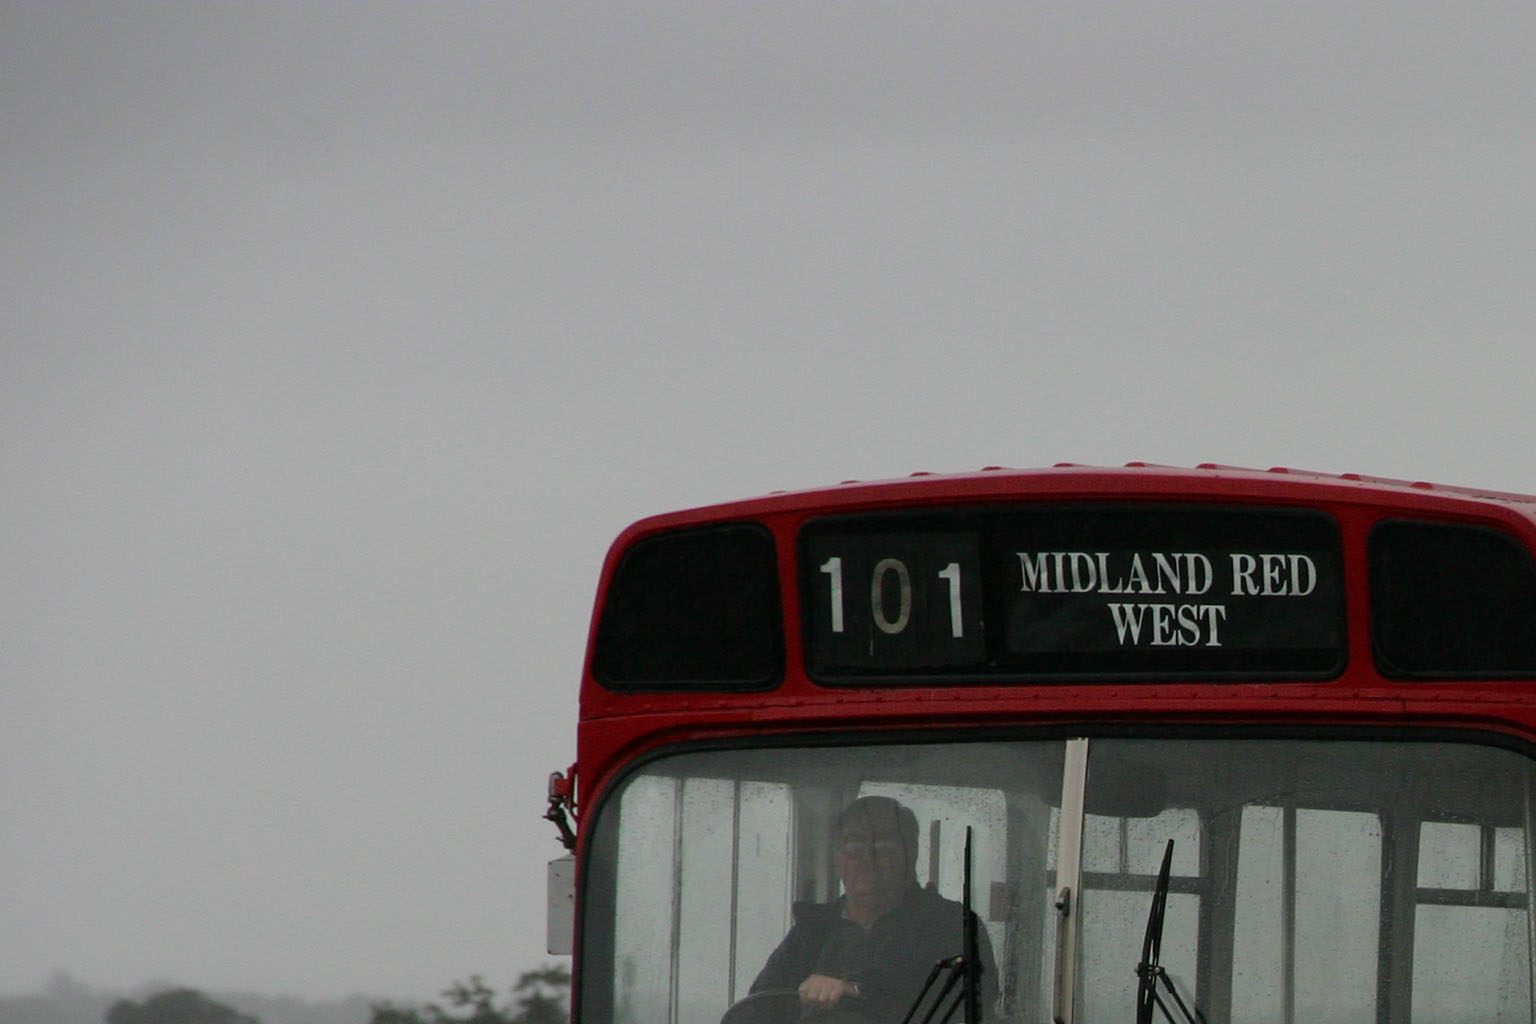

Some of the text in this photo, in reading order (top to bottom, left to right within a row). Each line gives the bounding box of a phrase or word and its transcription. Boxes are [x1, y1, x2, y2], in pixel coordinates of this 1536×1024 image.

[1017, 551, 1317, 597] MIDLAND RED
[1108, 603, 1227, 647] WEST
